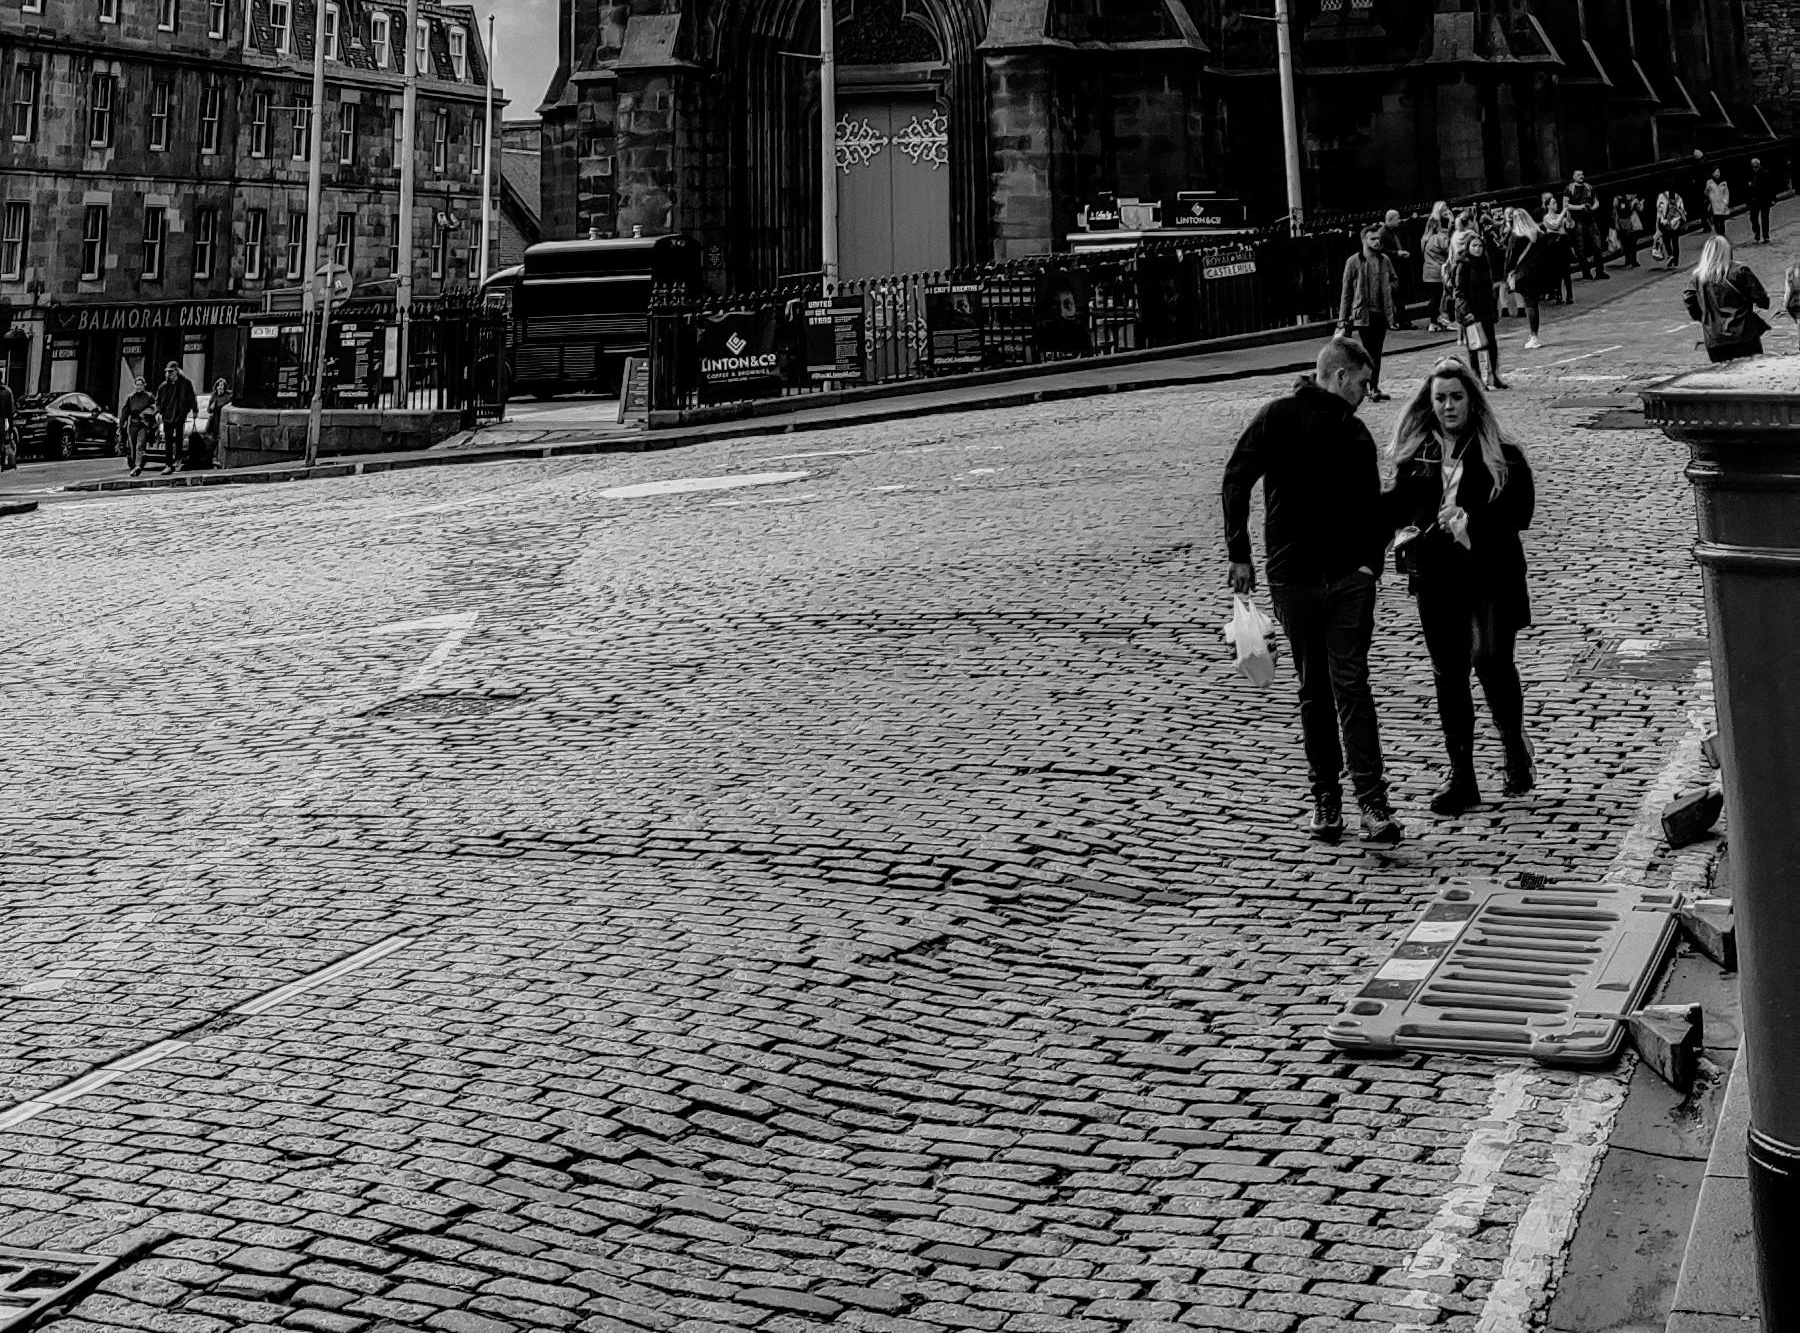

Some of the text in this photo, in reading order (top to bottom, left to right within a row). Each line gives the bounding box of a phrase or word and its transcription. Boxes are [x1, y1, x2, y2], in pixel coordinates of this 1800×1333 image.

[1206, 263, 1254, 278] CASTLEHILL
[78, 305, 241, 330] BALMORAL CASHMERE
